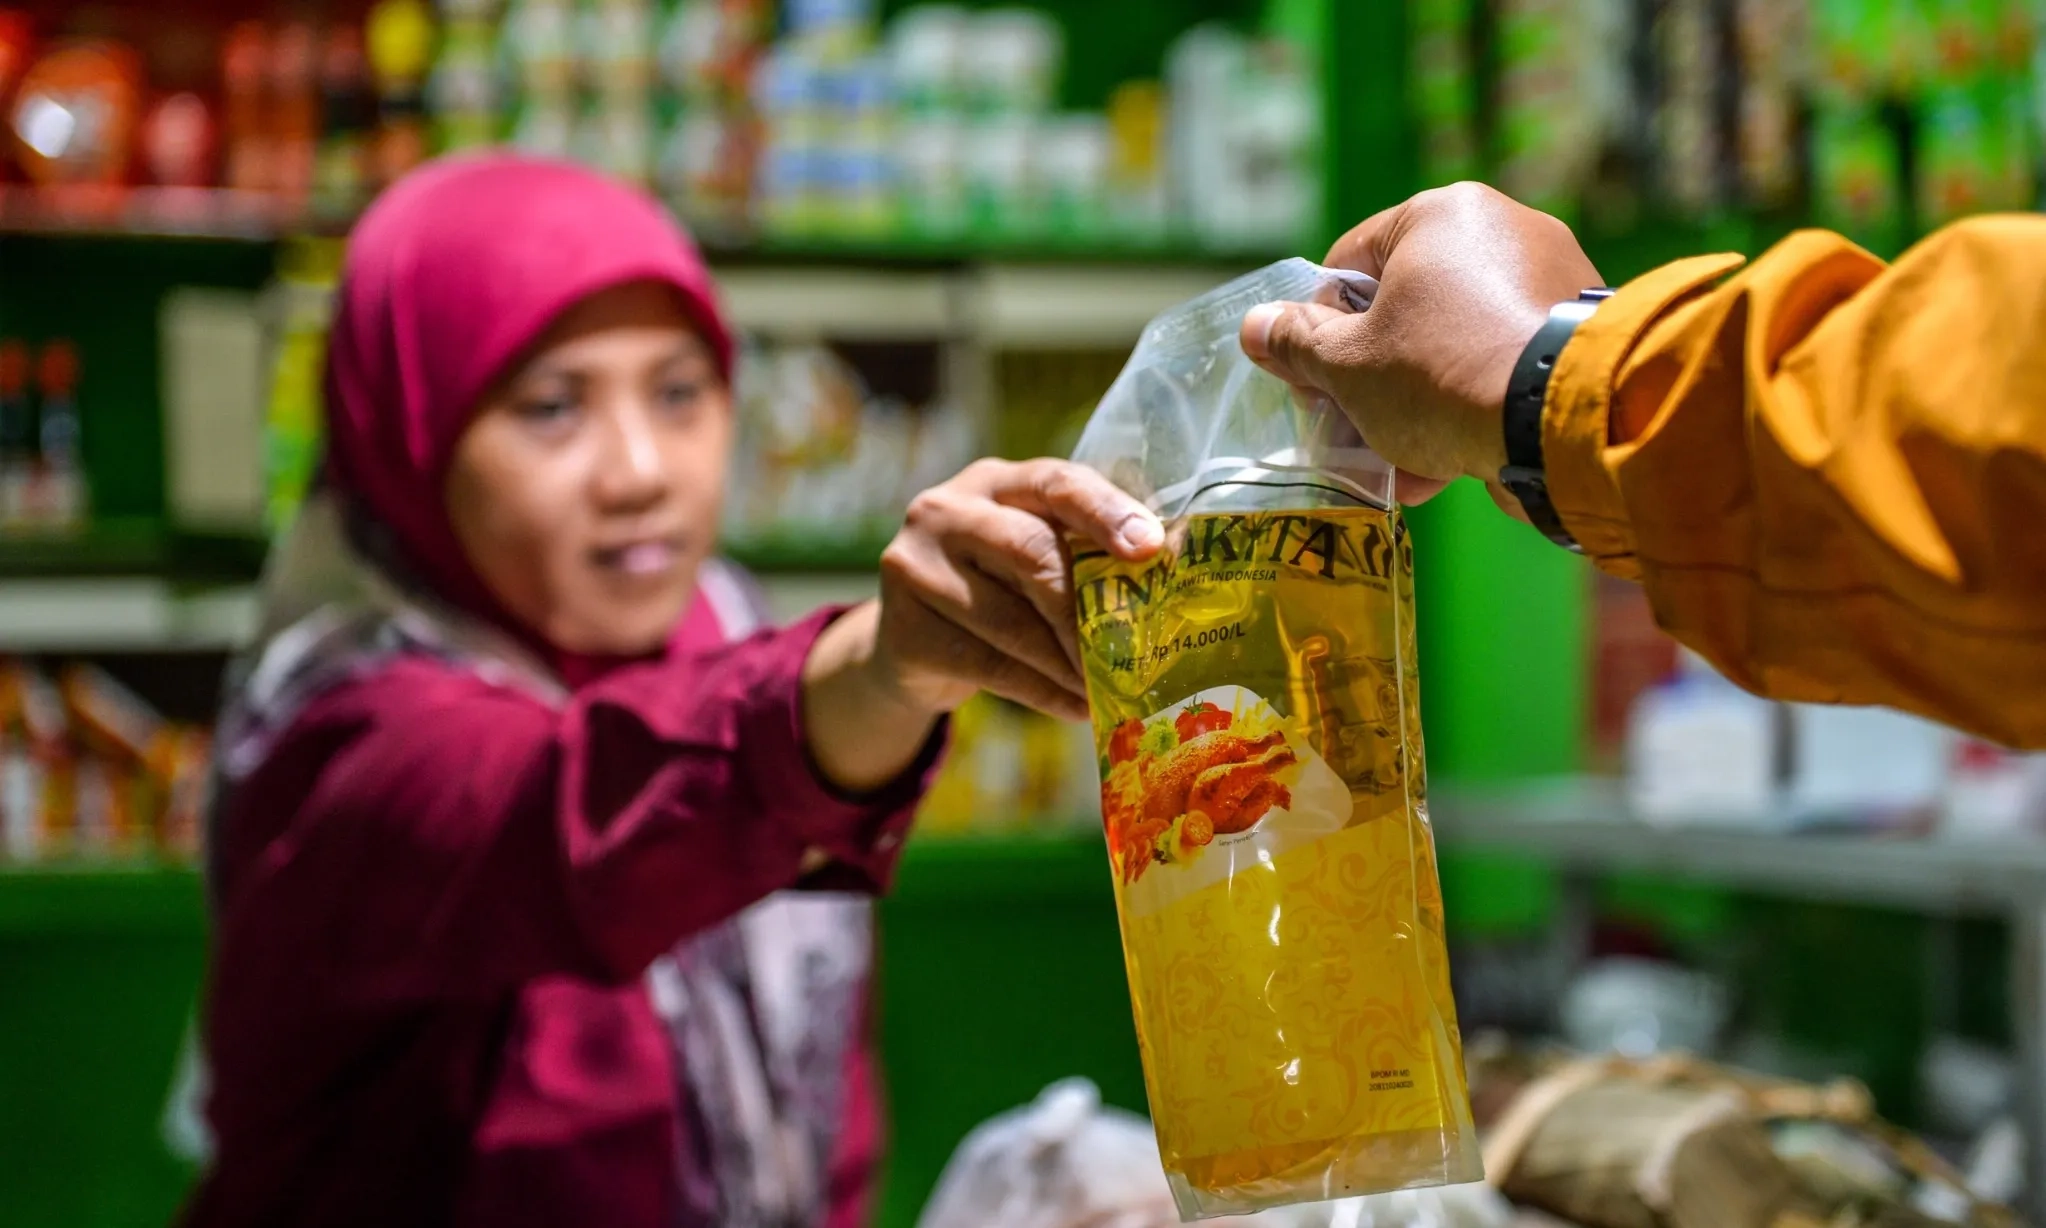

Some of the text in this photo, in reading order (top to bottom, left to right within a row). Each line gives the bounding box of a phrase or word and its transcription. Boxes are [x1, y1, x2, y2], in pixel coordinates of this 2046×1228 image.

[1175, 572, 1207, 592] SAWIT
[1211, 570, 1277, 582] INDONESIA
[1174, 622, 1246, 652] 14.000/L
[1371, 1070, 1391, 1078] BPOM
